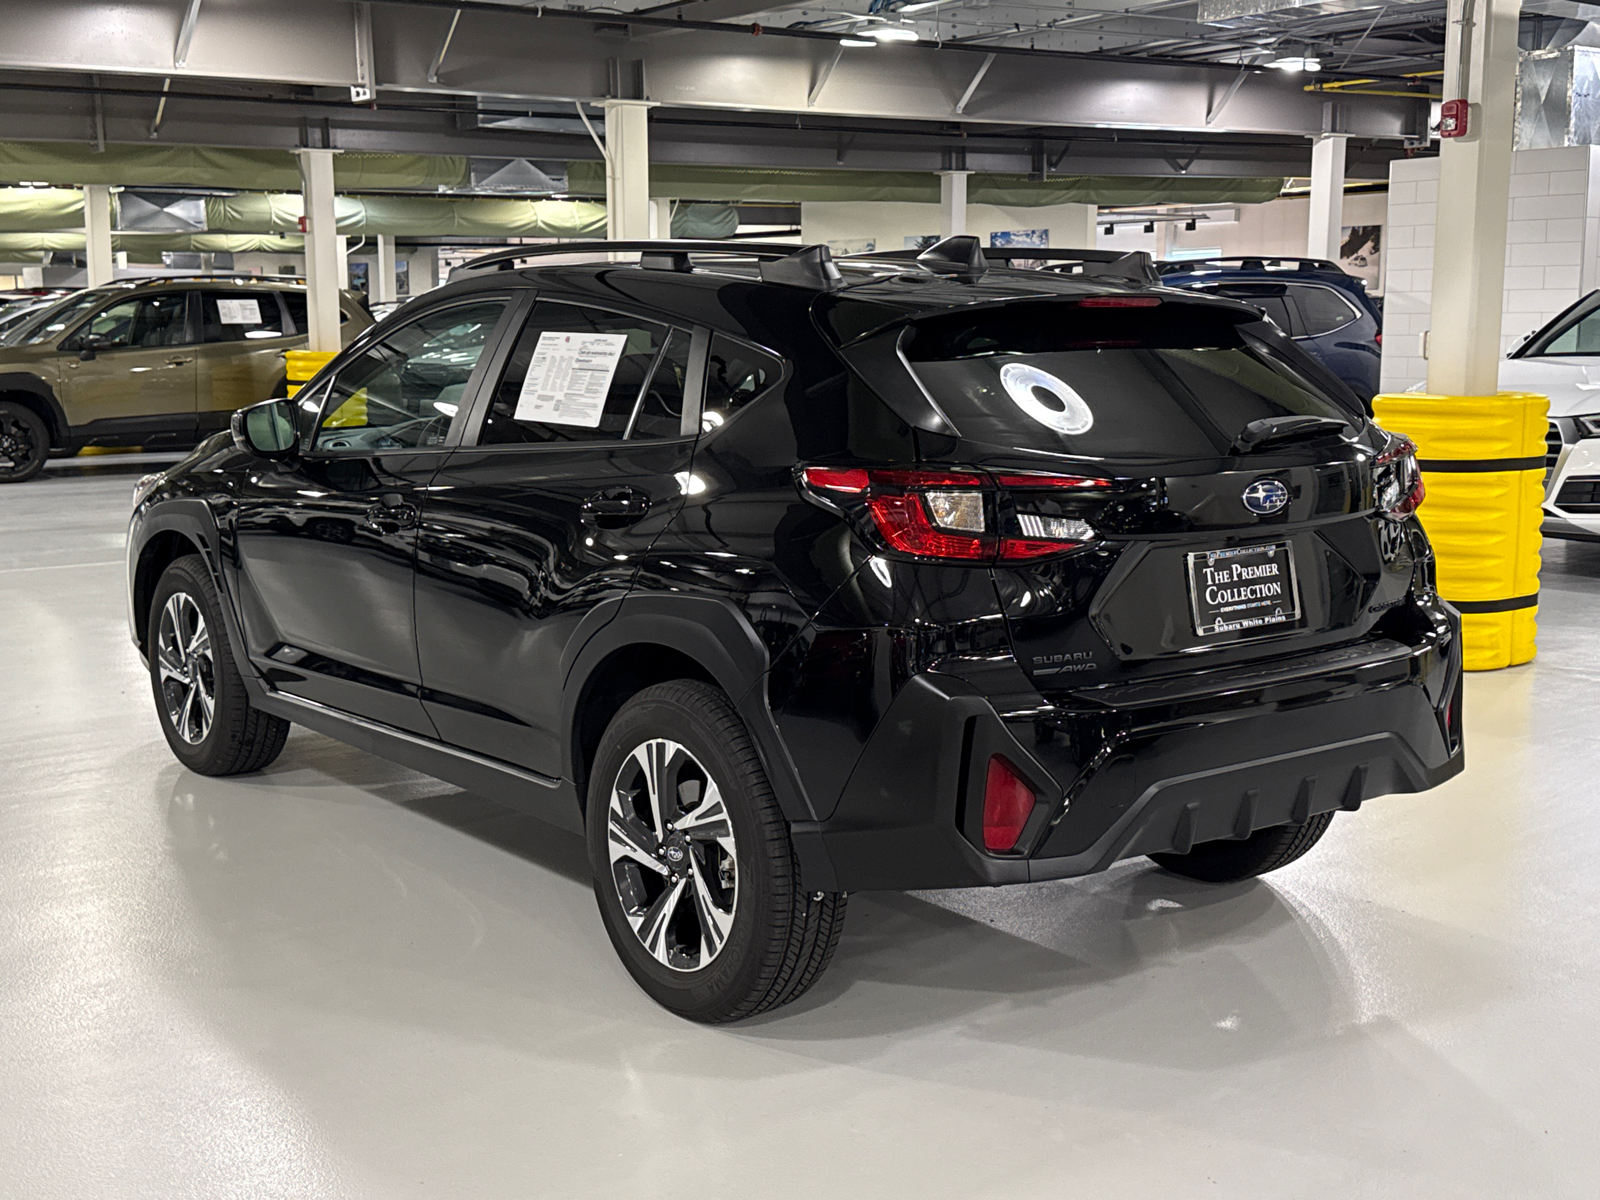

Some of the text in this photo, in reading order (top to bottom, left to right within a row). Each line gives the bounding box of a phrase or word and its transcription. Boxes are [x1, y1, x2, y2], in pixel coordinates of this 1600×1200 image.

[1203, 563, 1279, 585] THE PREMIER
[1205, 581, 1282, 605] COLLECTION
[1214, 615, 1286, 632] Subaru White Plains
[1032, 651, 1093, 665] SUBARU
[1058, 662, 1098, 674] AWD
